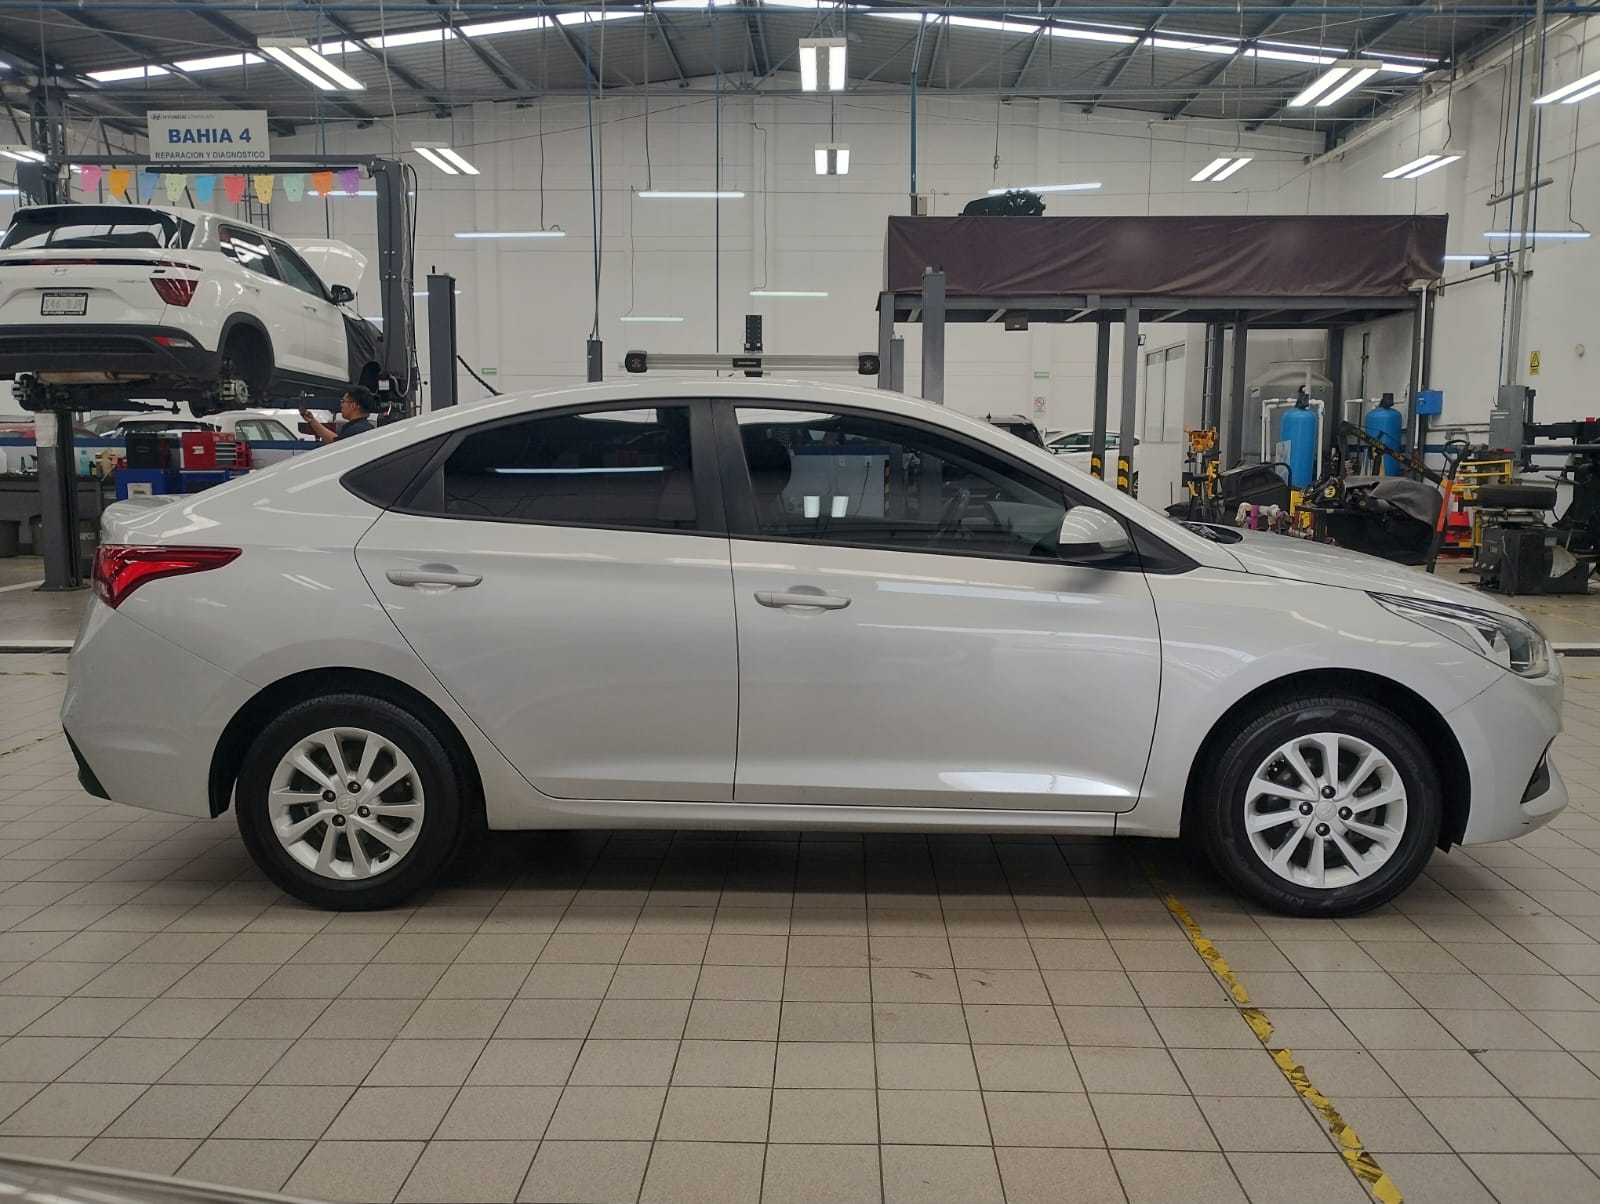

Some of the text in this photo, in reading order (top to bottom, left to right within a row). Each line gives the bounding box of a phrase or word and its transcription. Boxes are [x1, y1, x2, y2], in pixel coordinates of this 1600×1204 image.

[168, 127, 252, 144] BAHIA 4
[155, 151, 204, 159] REPARACION
